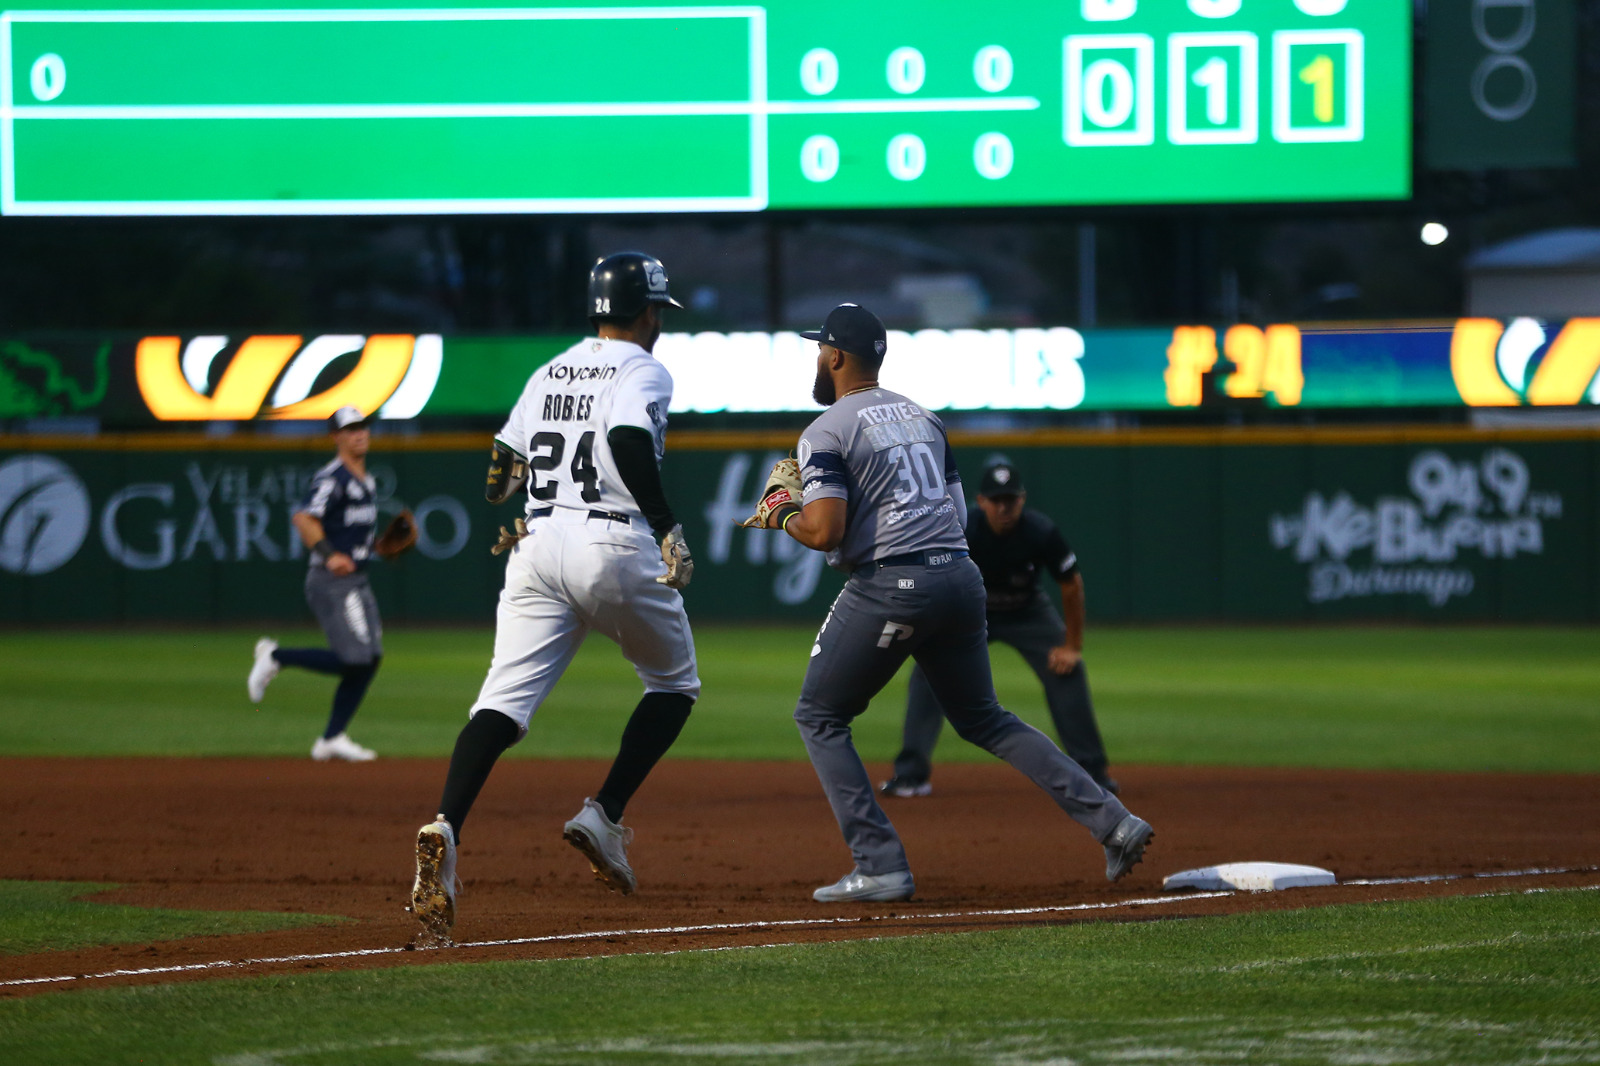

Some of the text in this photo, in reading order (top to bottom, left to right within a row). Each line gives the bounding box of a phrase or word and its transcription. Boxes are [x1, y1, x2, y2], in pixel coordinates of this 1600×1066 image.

[29, 52, 67, 102] 0
[799, 44, 1014, 96] 0 0 0
[1082, 54, 1334, 128] 0 1 1
[799, 131, 1014, 183] 0 0 0
[595, 297, 611, 314] 24
[542, 394, 594, 422] ROBES
[857, 402, 912, 426] TECATE
[872, 420, 931, 447] GARCIA
[529, 430, 602, 504] 24
[888, 443, 945, 504] 30
[929, 554, 941, 566] NEW
